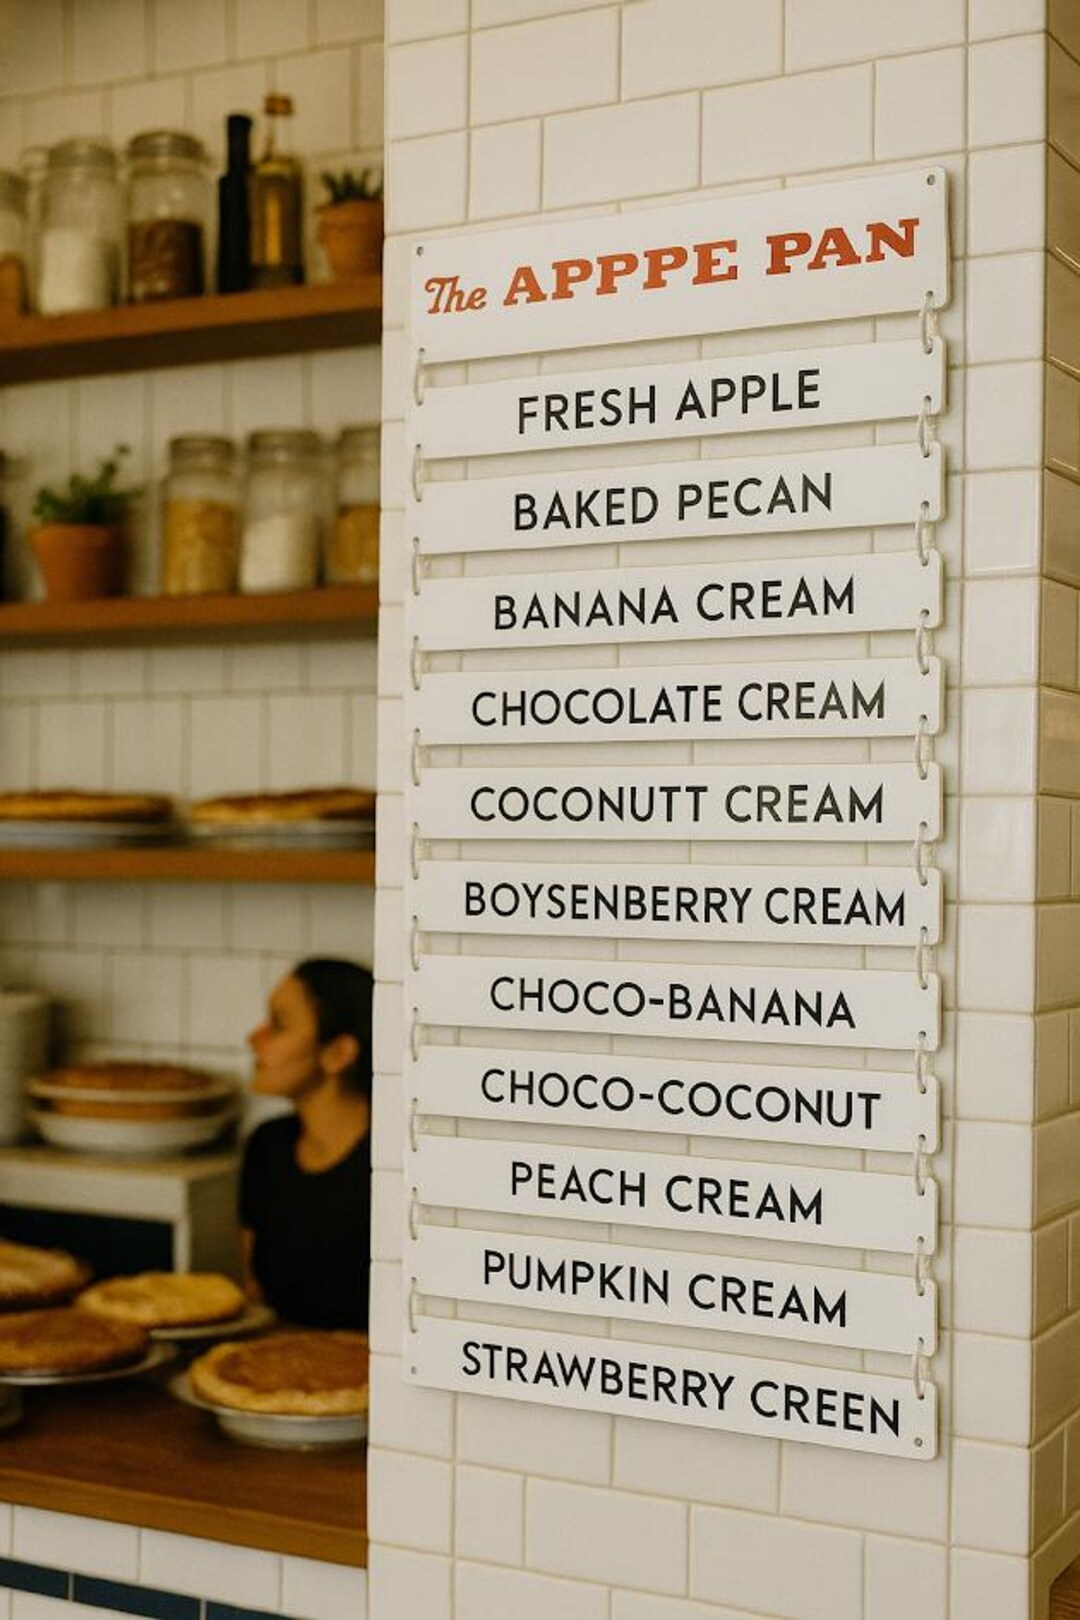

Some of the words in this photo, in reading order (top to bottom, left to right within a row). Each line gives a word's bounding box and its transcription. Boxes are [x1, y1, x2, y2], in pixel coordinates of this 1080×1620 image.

[424, 275, 488, 315] The
[503, 239, 738, 307] APPPE
[765, 217, 920, 276] PAN
[518, 384, 656, 435] FRESH
[674, 368, 821, 421] APPLE
[513, 486, 659, 532] BAKED
[678, 472, 832, 522] PECAN
[494, 584, 680, 631] BANANA
[696, 575, 855, 622] CREAM
[471, 684, 723, 727] CHOCOLATE
[737, 679, 885, 722] CREAM
[470, 785, 709, 823] COCONUTT
[724, 782, 884, 824] CREAM
[465, 881, 753, 924] BOYSENBERRY
[764, 886, 905, 927] CREAM
[489, 976, 857, 1030] CHOCO-BANANA
[480, 1068, 883, 1130] CHOCO-COCONUT
[511, 1160, 646, 1208] PEACH
[664, 1174, 823, 1226] CREAM
[483, 1248, 669, 1306] PUMPKIN
[688, 1273, 847, 1328] CREAM
[461, 1340, 736, 1411] STRAWBERRY
[749, 1380, 901, 1438] CREEN
